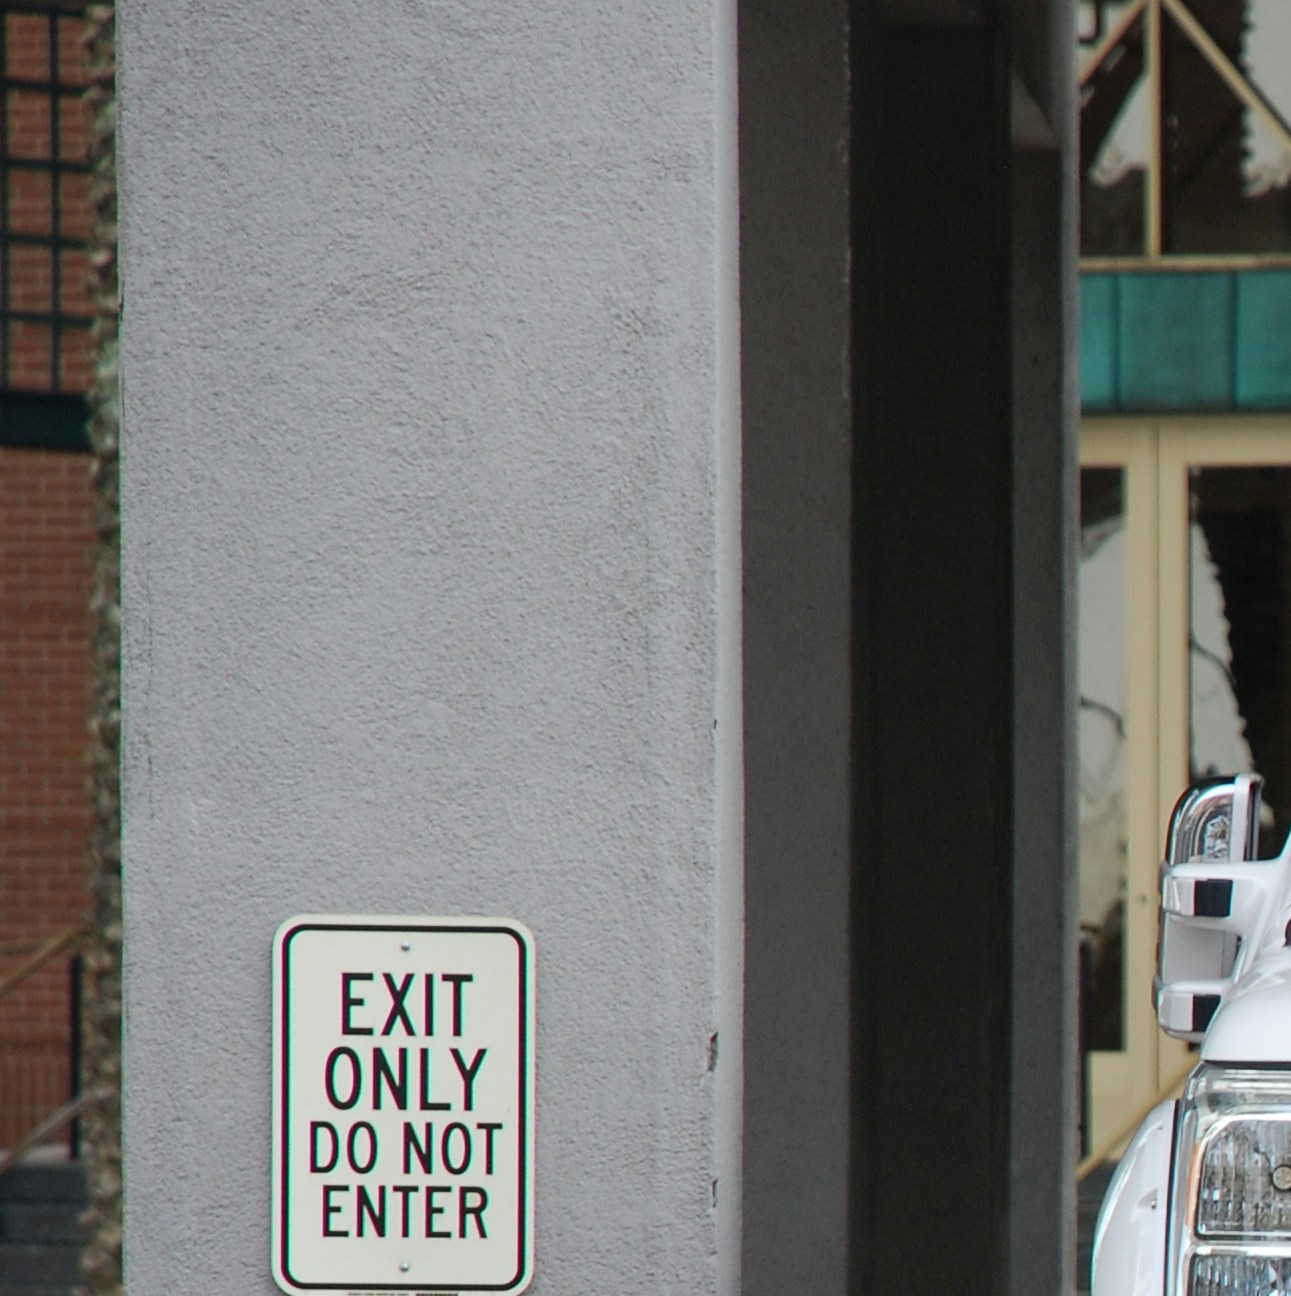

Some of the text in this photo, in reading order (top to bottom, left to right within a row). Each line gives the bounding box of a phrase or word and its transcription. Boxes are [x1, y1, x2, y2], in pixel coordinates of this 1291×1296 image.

[341, 972, 474, 1037] EXIT
[325, 1046, 488, 1112] ONLY
[310, 1121, 503, 1176] DO NOT
[322, 1184, 489, 1239] ENTER
